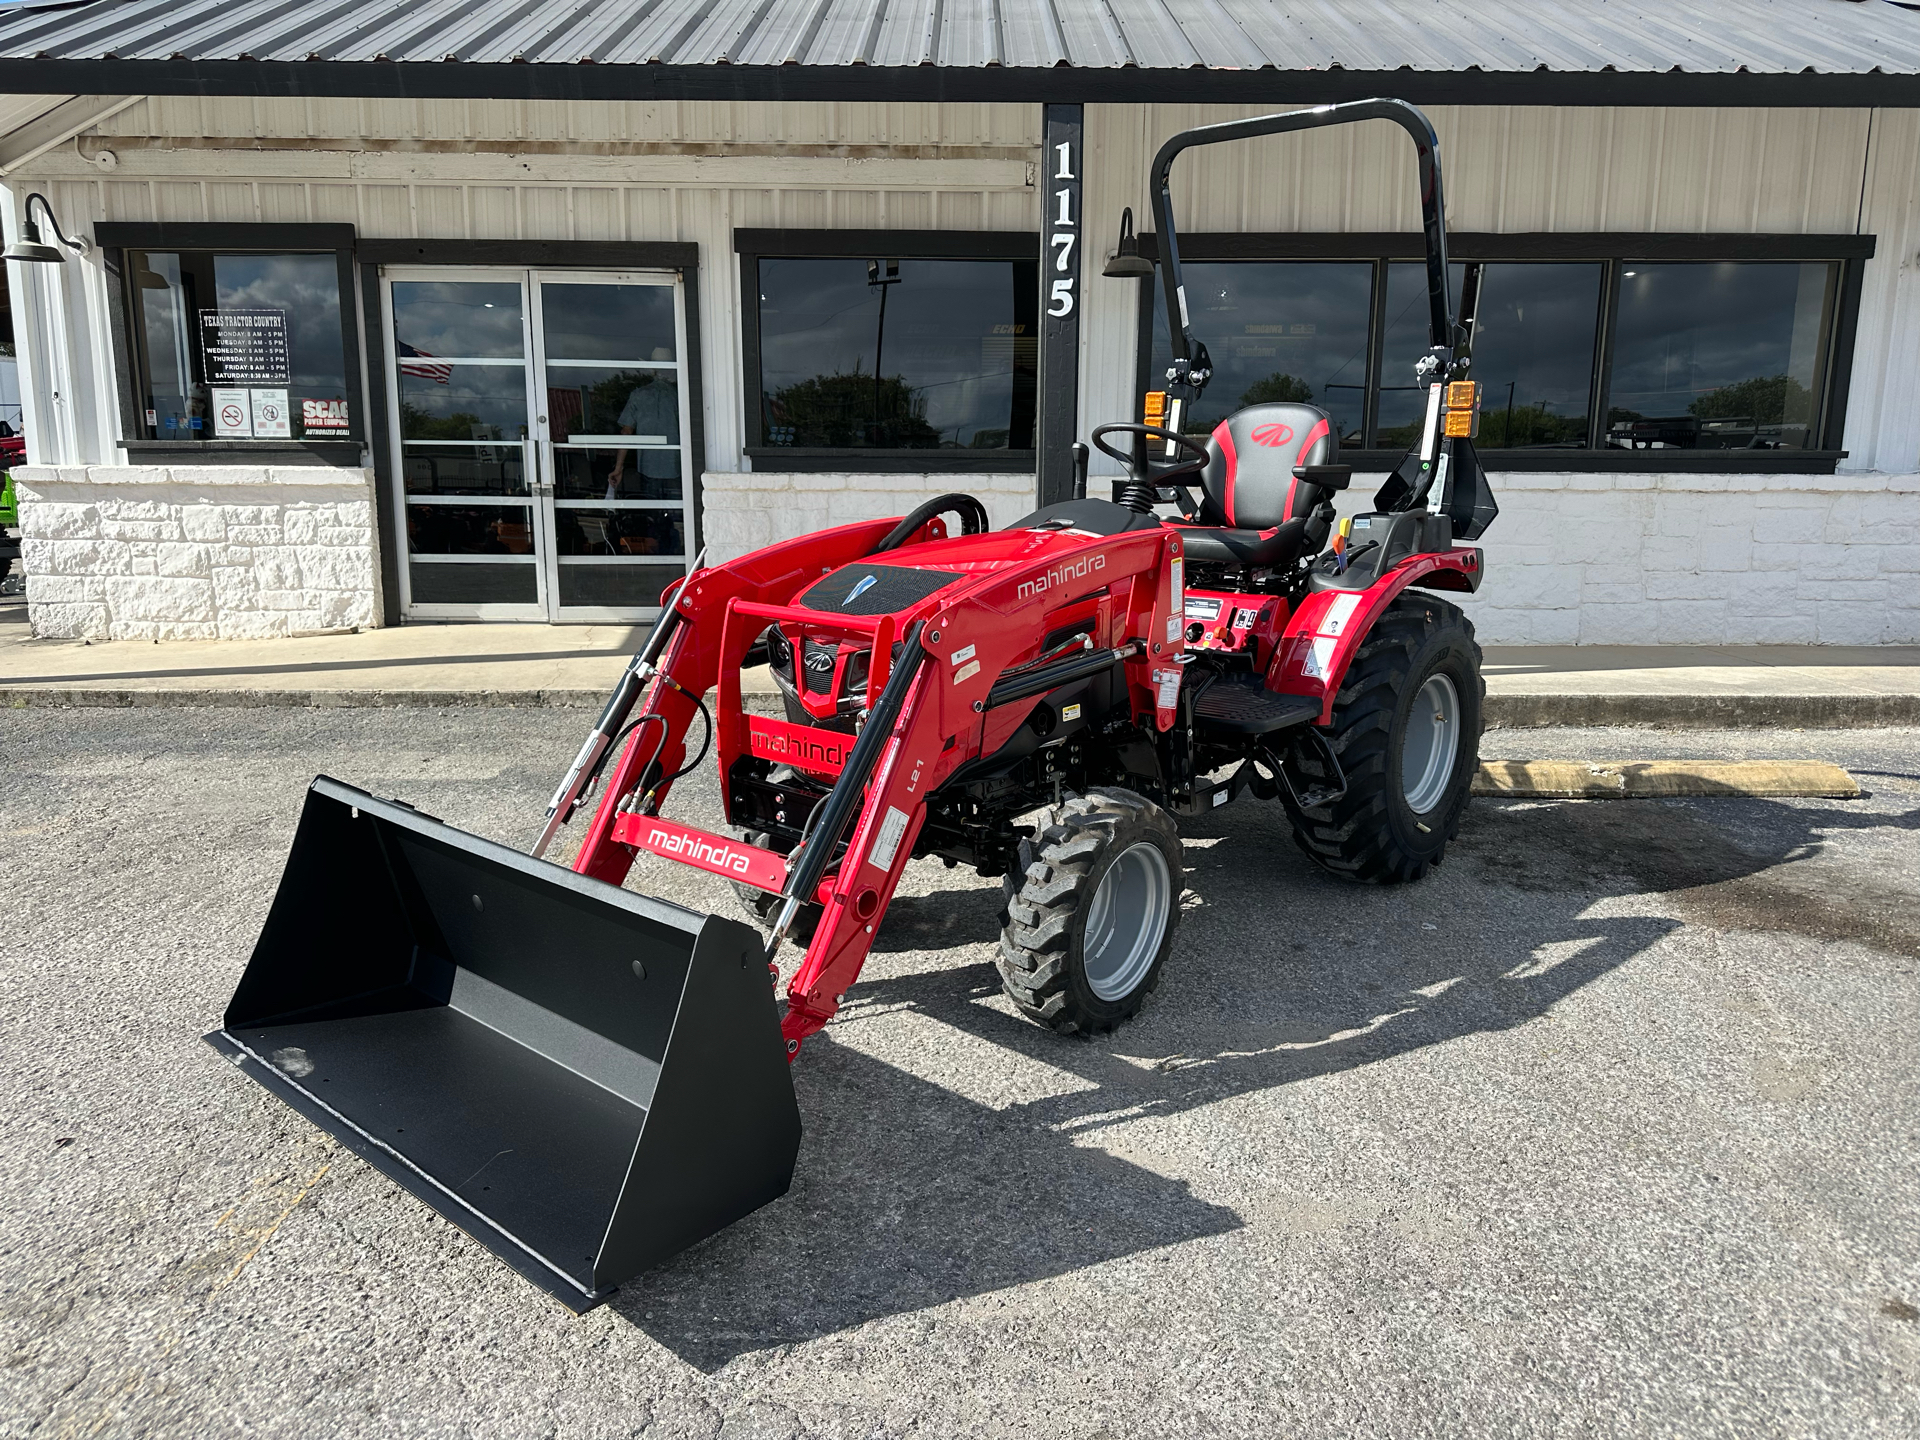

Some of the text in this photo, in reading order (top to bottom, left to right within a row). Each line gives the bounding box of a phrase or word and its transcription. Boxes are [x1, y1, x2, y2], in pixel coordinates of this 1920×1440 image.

[1047, 141, 1076, 318] 1175
[203, 315, 282, 328] TEXAS TRACTOR COUNTRY
[992, 324, 1026, 334] ECHO
[1017, 554, 1106, 600] mahindra
[906, 759, 924, 792] L21
[647, 829, 750, 874] mahindra
